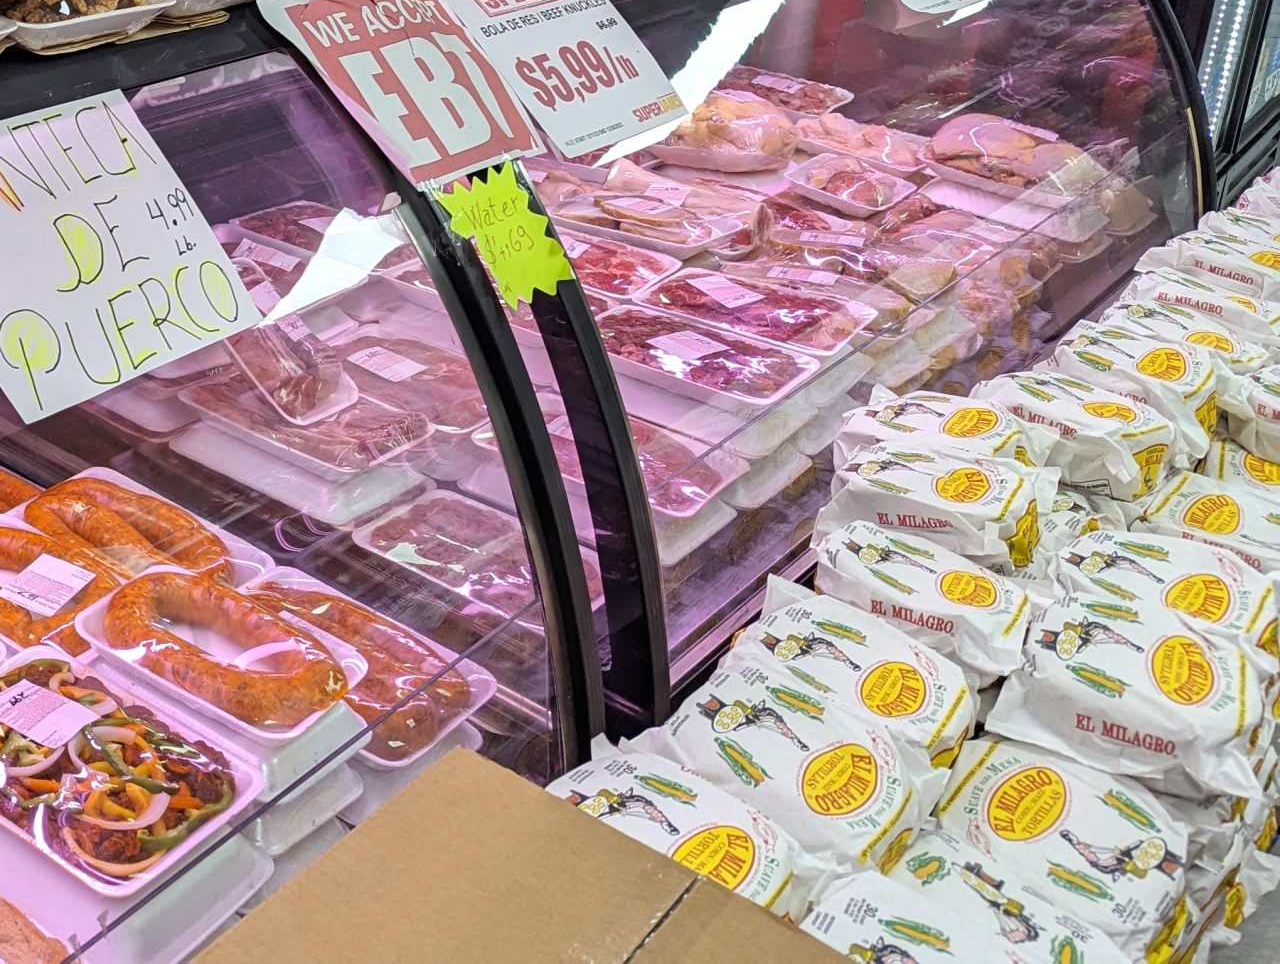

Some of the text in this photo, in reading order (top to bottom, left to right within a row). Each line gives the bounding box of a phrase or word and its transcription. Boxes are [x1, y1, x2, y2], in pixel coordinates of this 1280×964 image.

[304, 12, 360, 49] WE
[480, 22, 507, 38] BOLA
[506, 18, 522, 31] DE
[521, 13, 540, 25] RES
[542, 6, 564, 21] BEEF
[514, 40, 640, 112] $5,99/lb
[632, 93, 684, 123] SUPERJAMS
[145, 188, 195, 230] 4.99
[462, 197, 518, 231] Water
[53, 195, 150, 293] DE
[1208, 264, 1254, 285] MILAGRO
[1157, 292, 1223, 315] EL MILAGRO
[1012, 407, 1025, 418] EL
[1257, 404, 1268, 416] EL
[877, 513, 954, 529] EL MILAGRO
[1188, 495, 1229, 526] MILAGRO
[871, 599, 954, 634] EL MILAGRO
[865, 667, 894, 702] TORTILLAS
[876, 668, 920, 715] EL MILAGRO
[1173, 658, 1208, 702] MILAGRO
[1076, 714, 1176, 757] EL MILAGRO
[806, 752, 845, 790] TORTILLAS
[815, 753, 872, 812] EL MILAGRO
[963, 785, 985, 816] SUAVE
[991, 756, 1021, 776] MESA
[994, 769, 1052, 835] EL MILAGRO
[1015, 809, 1031, 825] CORN
[1022, 789, 1063, 836] TORTILLAS
[681, 832, 719, 865] TORTILL
[708, 833, 749, 885] EL MILA
[761, 856, 780, 892] SUAVE
[1112, 903, 1127, 918] 30
